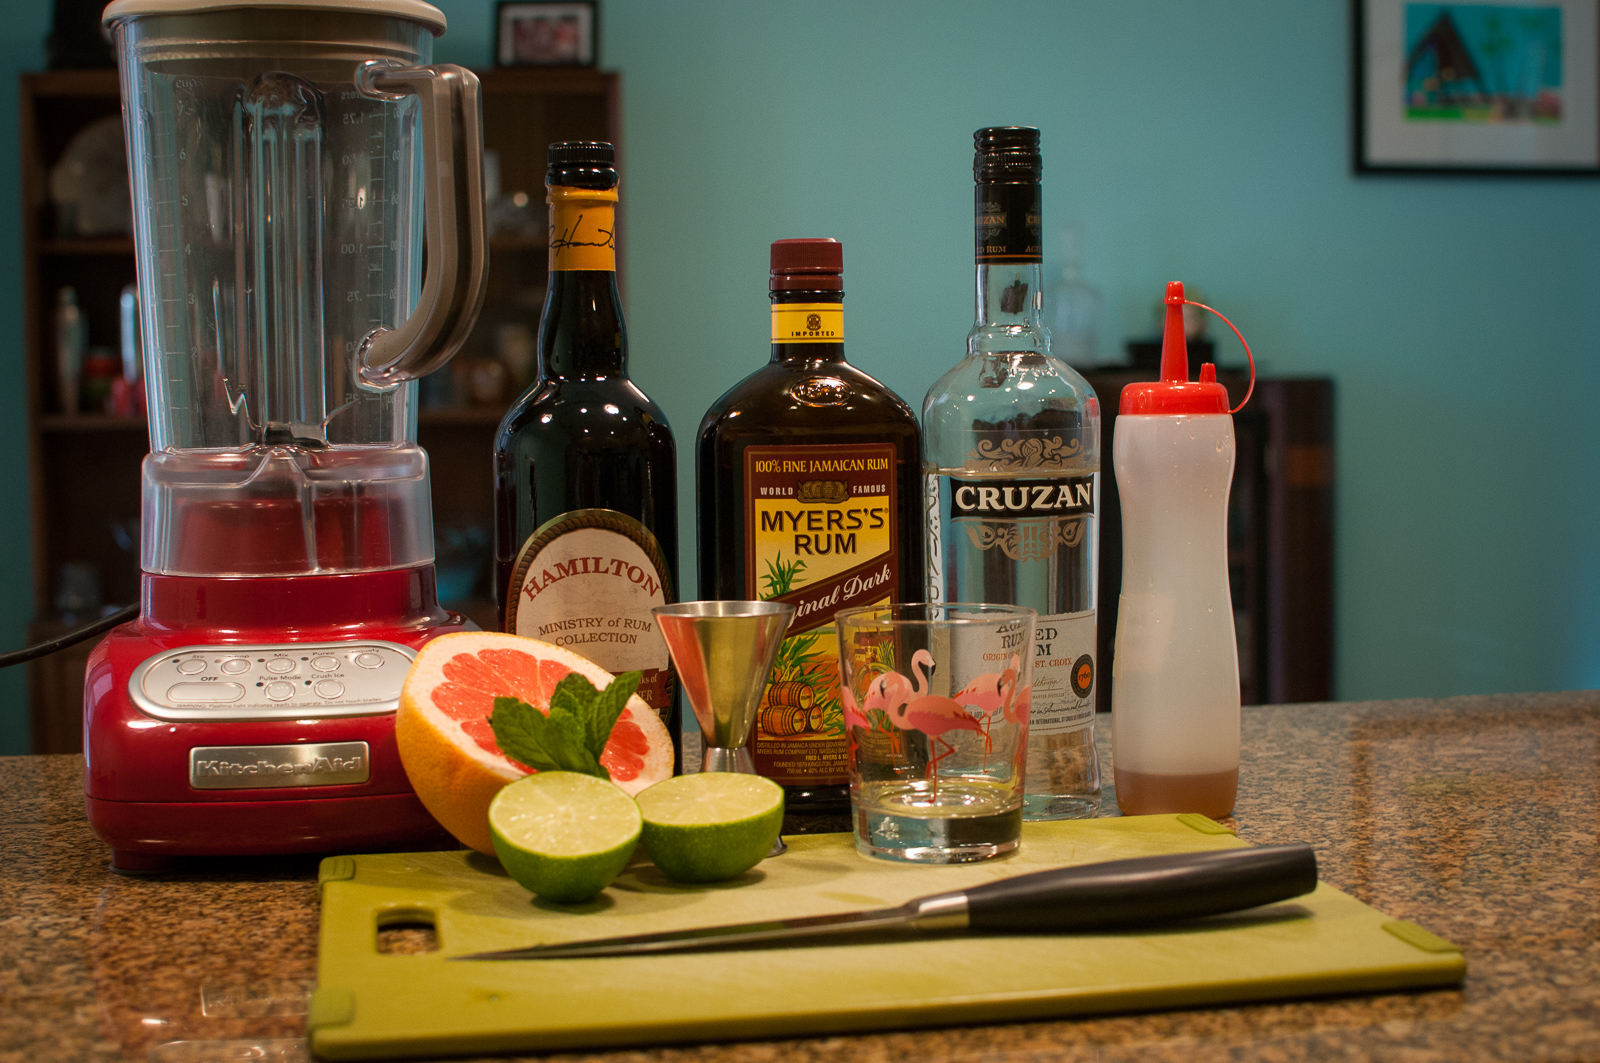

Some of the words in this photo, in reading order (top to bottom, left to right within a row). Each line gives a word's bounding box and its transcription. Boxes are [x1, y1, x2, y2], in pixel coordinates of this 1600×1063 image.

[175, 79, 203, 90] cups
[180, 149, 187, 160] 6
[182, 195, 189, 206] 5
[184, 243, 191, 255] 4
[986, 245, 1006, 253] RUM
[188, 293, 195, 304] 3
[755, 459, 782, 473] 100%
[783, 460, 807, 473] FINE
[809, 459, 865, 473] JAMAICAN
[867, 458, 889, 471] RUM
[760, 487, 794, 496] WORLD
[852, 484, 886, 494] FAMOUS
[955, 482, 1092, 512] CRUZAN
[761, 507, 884, 533] MYERS'S
[794, 532, 857, 556] RUM
[522, 556, 660, 602] HAMILTON
[843, 563, 892, 601] Dark
[538, 617, 604, 636] MINISTRY
[607, 617, 620, 628] of
[624, 618, 652, 633] RUM
[555, 632, 638, 647] COLLECTION
[1035, 660, 1047, 668] ST.
[1049, 657, 1072, 668] CROIX
[650, 673, 658, 684] of
[1078, 671, 1091, 682] 1760
[197, 756, 362, 776] KitchenAid
